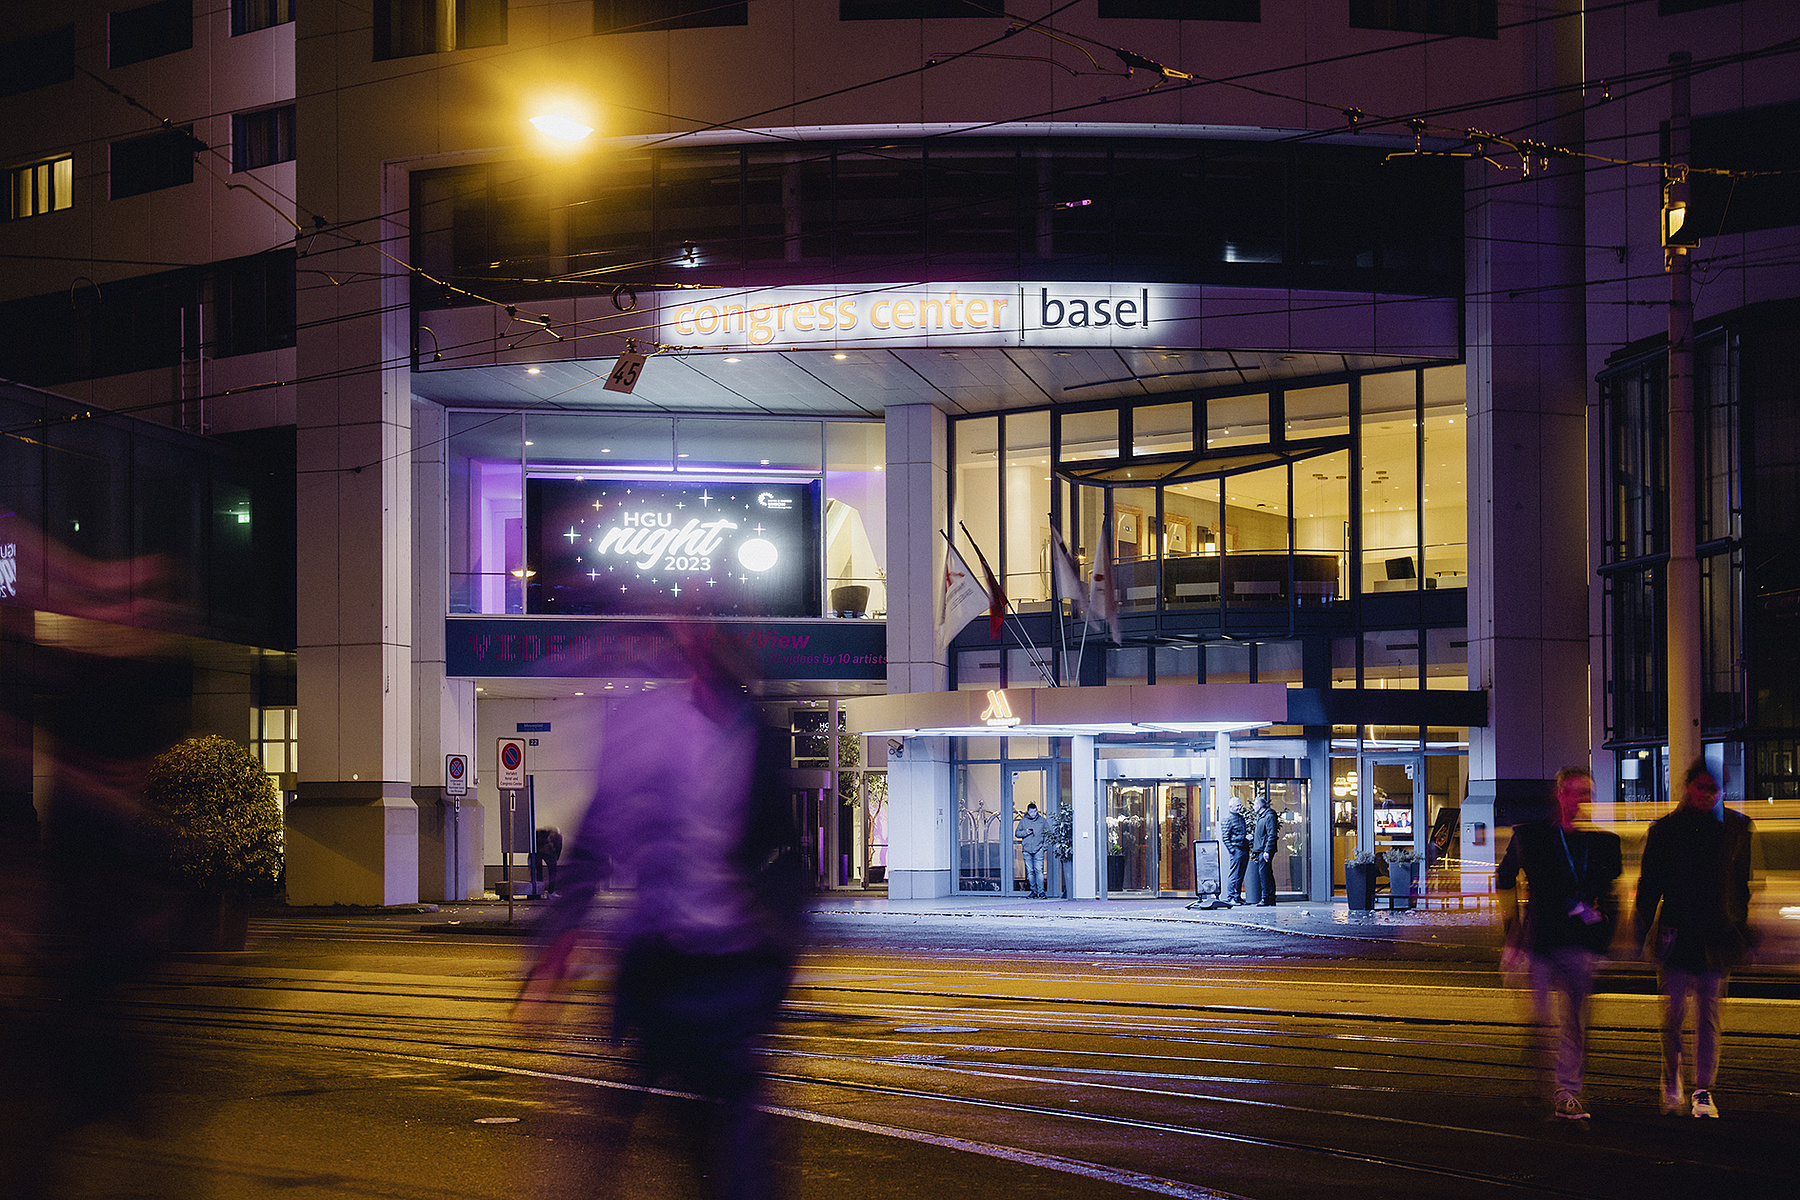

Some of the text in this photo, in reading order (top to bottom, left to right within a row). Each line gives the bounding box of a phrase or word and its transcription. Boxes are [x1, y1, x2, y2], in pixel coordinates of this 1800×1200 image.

[673, 287, 1149, 346] congress center basel
[612, 360, 641, 386] 45
[623, 512, 672, 527] HGU
[598, 518, 738, 570] night
[664, 556, 711, 571] 2023
[768, 652, 888, 666] 10 videos by 10 artists
